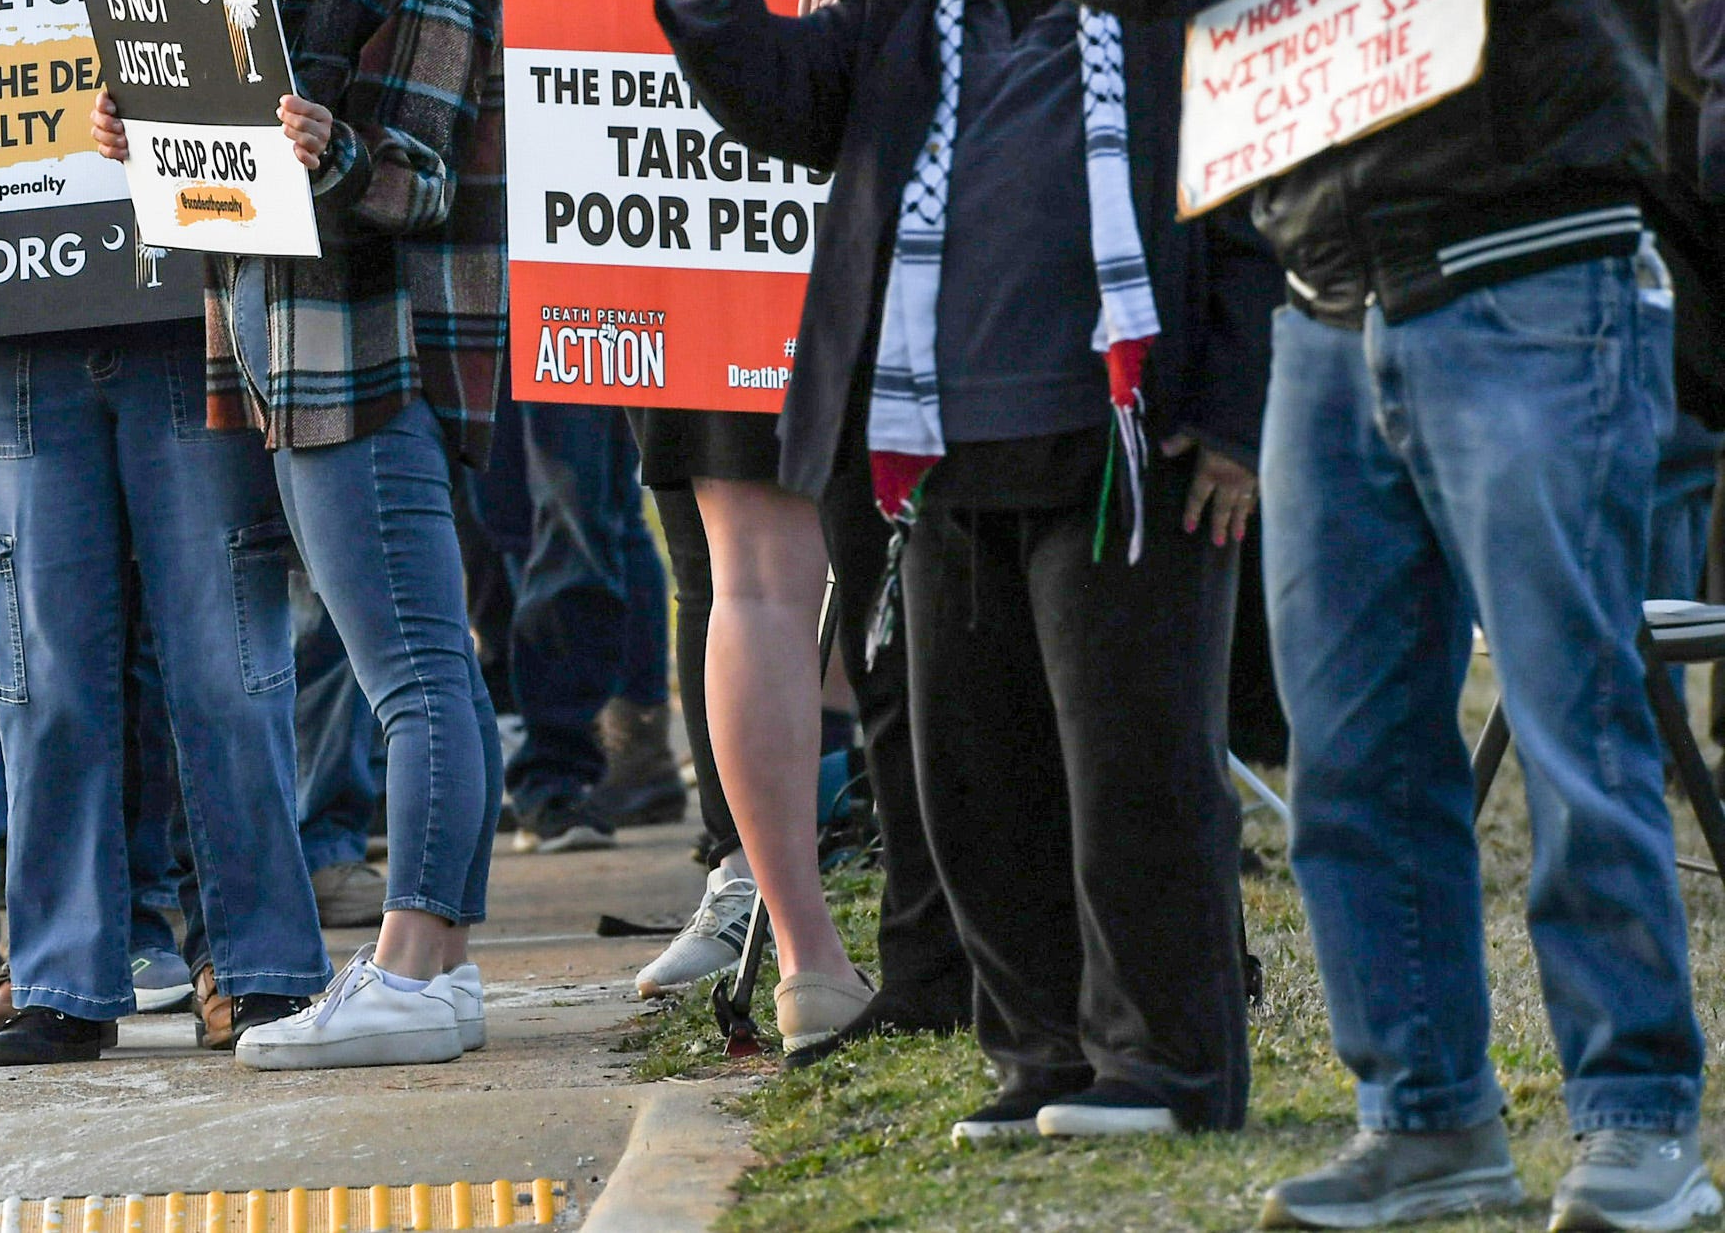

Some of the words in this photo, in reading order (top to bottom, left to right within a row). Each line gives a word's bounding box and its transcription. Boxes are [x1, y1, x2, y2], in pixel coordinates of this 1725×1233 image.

[115, 39, 190, 88] JUSTICE
[1203, 3, 1360, 100] WITHOUT
[1254, 57, 1333, 125] CAST
[1358, 21, 1412, 74] THE
[530, 66, 600, 106] THE
[1203, 121, 1299, 194] FIRST
[1323, 51, 1433, 139] STONE
[608, 126, 832, 185] TARGE
[545, 191, 691, 249] POOR
[543, 307, 590, 323] DEATH
[597, 309, 666, 326] PENALTY
[535, 324, 665, 388] ACTION
[727, 364, 793, 389] DeathP
